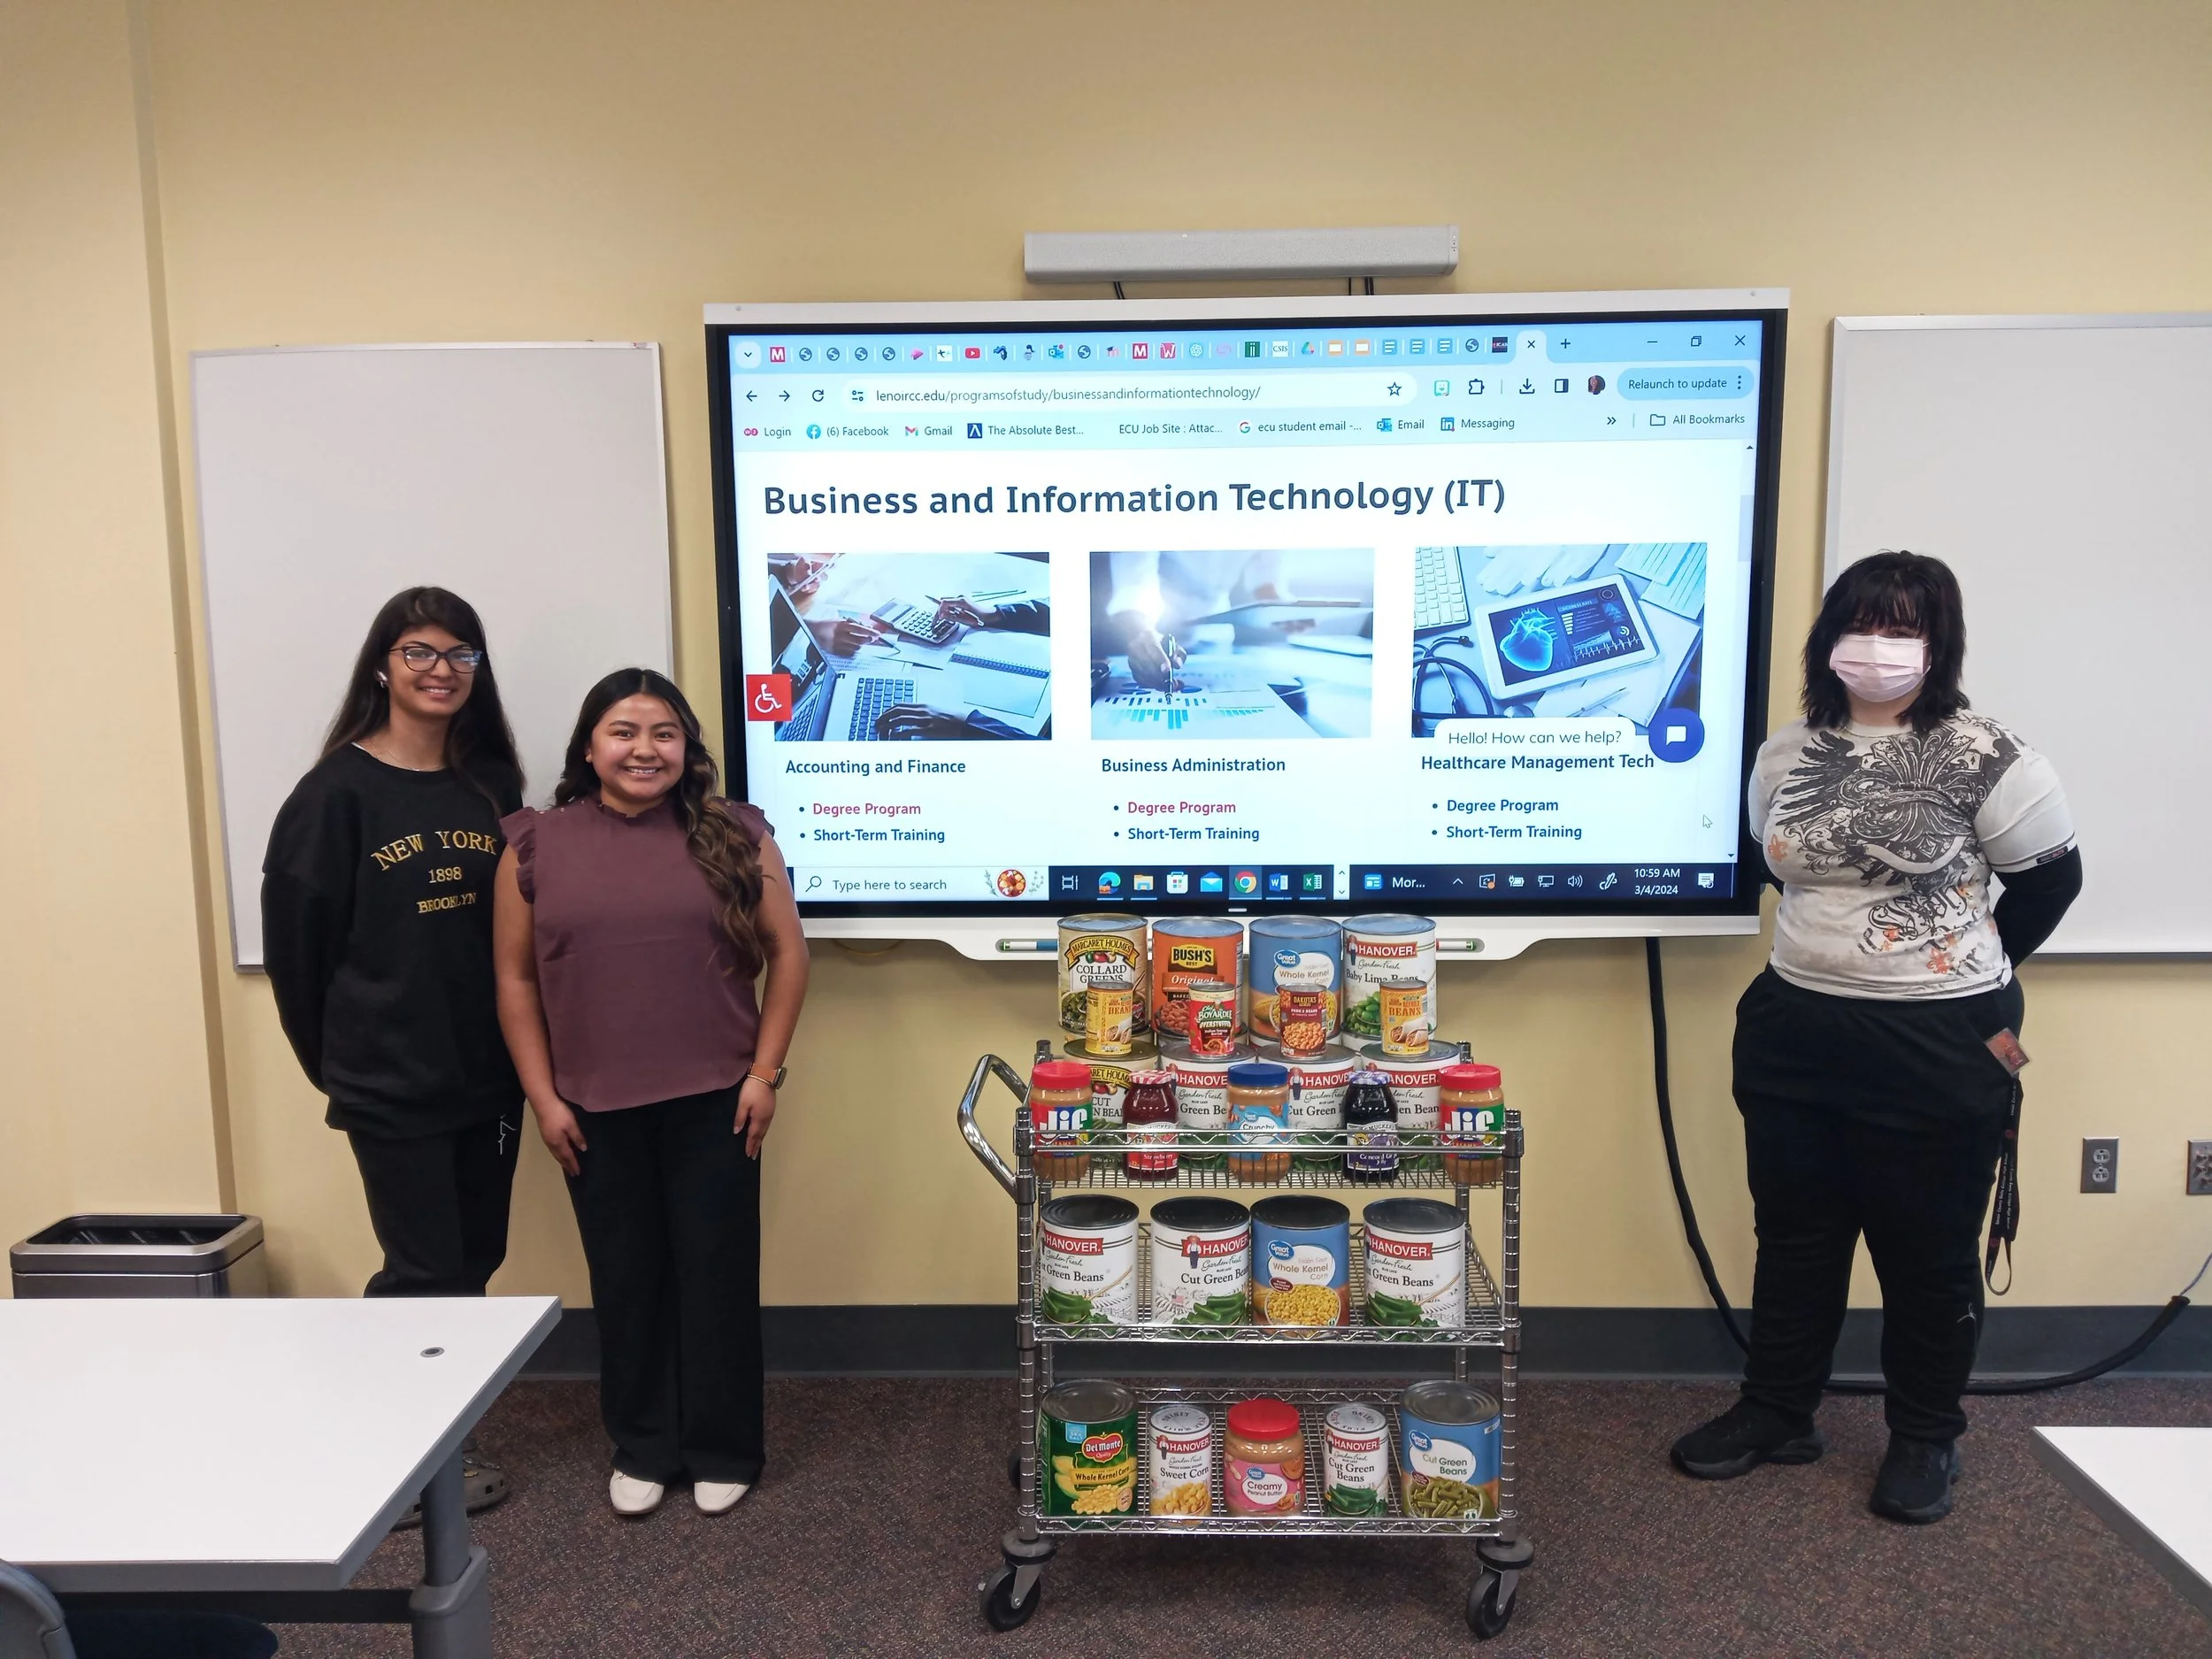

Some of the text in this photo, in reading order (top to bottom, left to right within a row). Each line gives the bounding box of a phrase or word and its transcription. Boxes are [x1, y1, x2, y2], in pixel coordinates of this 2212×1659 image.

[1628, 378, 1727, 390] Relaunch to update
[876, 386, 1261, 404] lenoircc.edu/programsofstudy/businessandinformationtechnology/
[1397, 419, 1425, 430] Email
[1461, 418, 1515, 430] Messaging
[1672, 413, 1745, 425] All Bookmarks
[764, 426, 791, 438] Login
[826, 426, 888, 437] (6) Facebook
[924, 426, 953, 436] Gmail
[988, 425, 1084, 435] The Absolute Best...
[1119, 423, 1223, 434] ECU Job Site Attac...
[1278, 422, 1316, 432] student
[1318, 421, 1346, 431] email
[764, 479, 1505, 516] Business and Information Technology (IT)
[1448, 730, 1622, 746] Hello! How can we help?
[786, 759, 966, 777] Accounting and Finance
[1102, 757, 1286, 772] Business Administration
[1421, 753, 1655, 772] Healthcare Management Tech
[812, 803, 921, 817] Degree Program
[1128, 802, 1236, 816] Degree Program
[1447, 799, 1559, 814] Degree Program
[813, 828, 945, 843] Short-Term Training
[1128, 827, 1260, 841] Short-Term Training
[1447, 826, 1582, 840] Short-Term Training
[371, 830, 498, 872] NEW YORK
[428, 866, 463, 884] 1898
[1634, 868, 1680, 879] 10:59 AM
[833, 879, 947, 893] Type here to search
[1392, 876, 1425, 888] Mor...
[1634, 885, 1678, 895] 3/4/2024
[416, 892, 478, 914] BROOKLYN
[1071, 939, 1132, 953] MARGARET HOLMES
[1173, 949, 1212, 963] BUSH'S
[1076, 964, 1127, 975] COLLARD
[1279, 970, 1305, 979] Whole
[1346, 968, 1363, 983] Baby
[1388, 1007, 1421, 1017] BEANS
[1179, 1103, 1210, 1115] Green
[1306, 1105, 1336, 1116] Green
[1039, 1108, 1088, 1140] Jif
[1444, 1110, 1494, 1141] Jif
[1046, 1263, 1104, 1282] Green Beans
[1272, 1263, 1329, 1273] Whole Kernel
[1180, 1272, 1233, 1285] Cut Green
[1372, 1268, 1434, 1287] Green Beans
[1085, 1440, 1121, 1452] Del Monte
[1328, 1456, 1375, 1473] Cut Green
[1422, 1453, 1468, 1467] Cut Green
[1097, 1471, 1118, 1481] Kernel
[1118, 1465, 1130, 1476] Corn
[1160, 1466, 1210, 1479] Sweet Corn
[1336, 1470, 1364, 1482] Beans
[1440, 1466, 1468, 1476] Beans
[1247, 1481, 1283, 1491] Creamy
